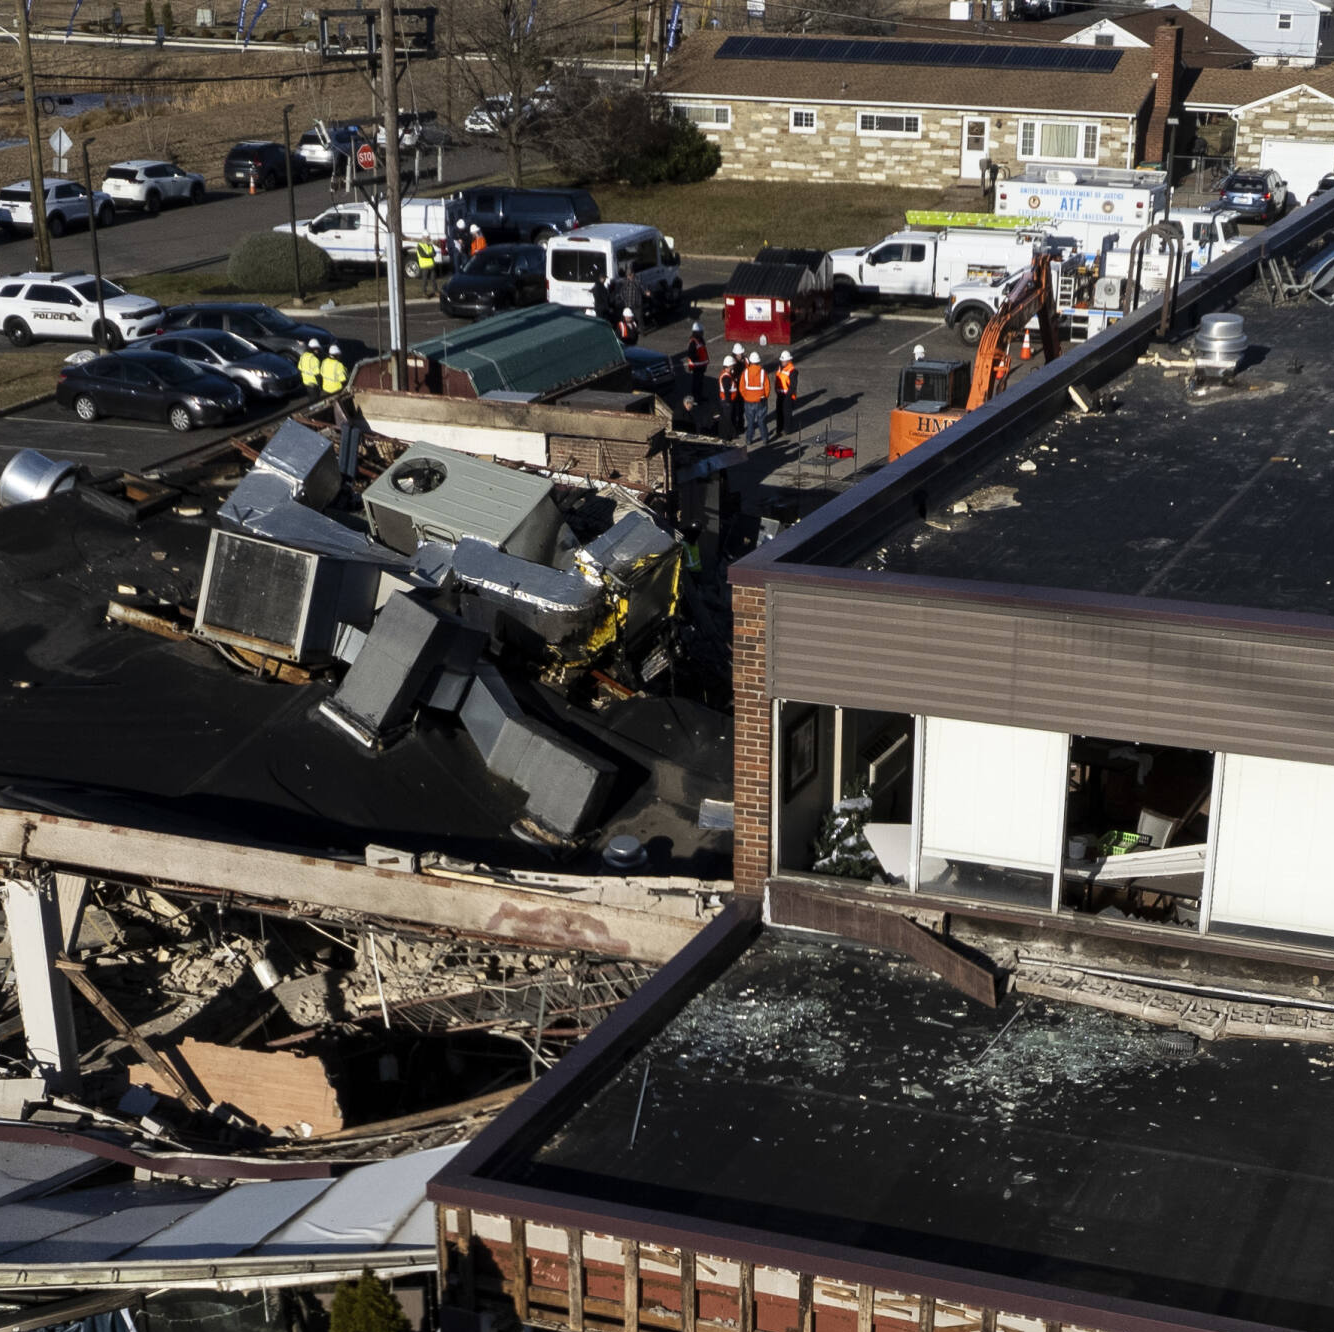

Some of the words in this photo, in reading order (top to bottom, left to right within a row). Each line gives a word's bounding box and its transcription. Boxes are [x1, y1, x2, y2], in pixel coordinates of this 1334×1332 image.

[358, 151, 374, 162] STO
[1020, 187, 1038, 195] UNITED
[1041, 188, 1058, 196] STATES
[1059, 189, 1093, 198] DEPARTMENT
[1104, 192, 1124, 200] JUSTICE
[1060, 197, 1083, 212] ATF
[33, 311, 65, 321] POLICE
[917, 416, 957, 433] HM
